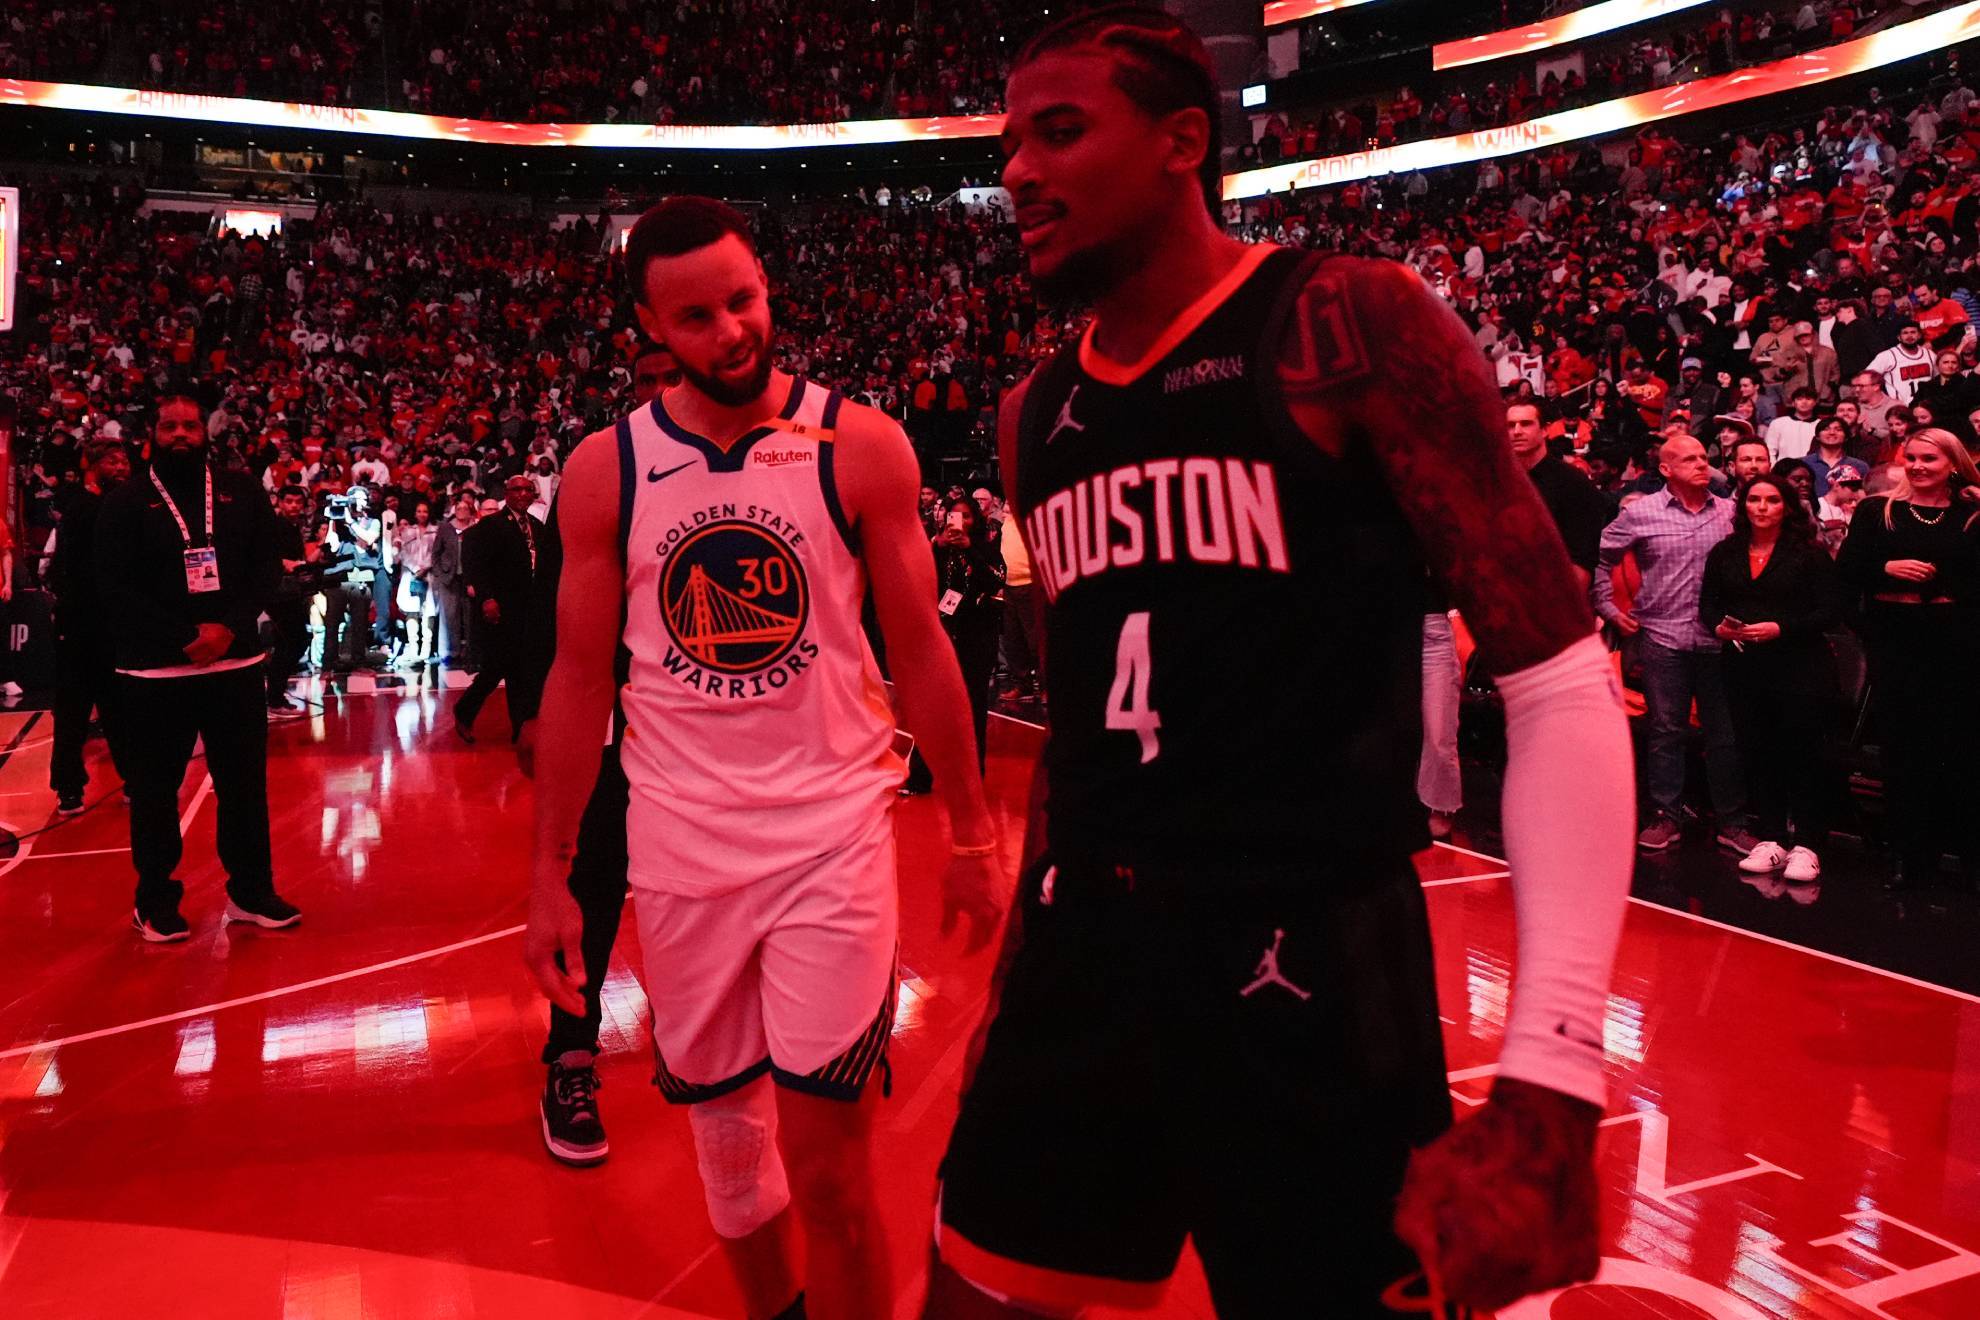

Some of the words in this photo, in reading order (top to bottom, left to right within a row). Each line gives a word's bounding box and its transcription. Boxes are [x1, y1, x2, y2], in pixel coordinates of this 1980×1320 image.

[1475, 123, 1540, 150] WIN
[753, 449, 812, 464] Rakuten
[656, 504, 735, 556] GOLDEN
[746, 505, 803, 547] STATE
[1025, 457, 1290, 604] HOUSTON
[736, 556, 789, 599] 30
[662, 639, 819, 698] WARRIORS
[1105, 611, 1162, 764] 4
